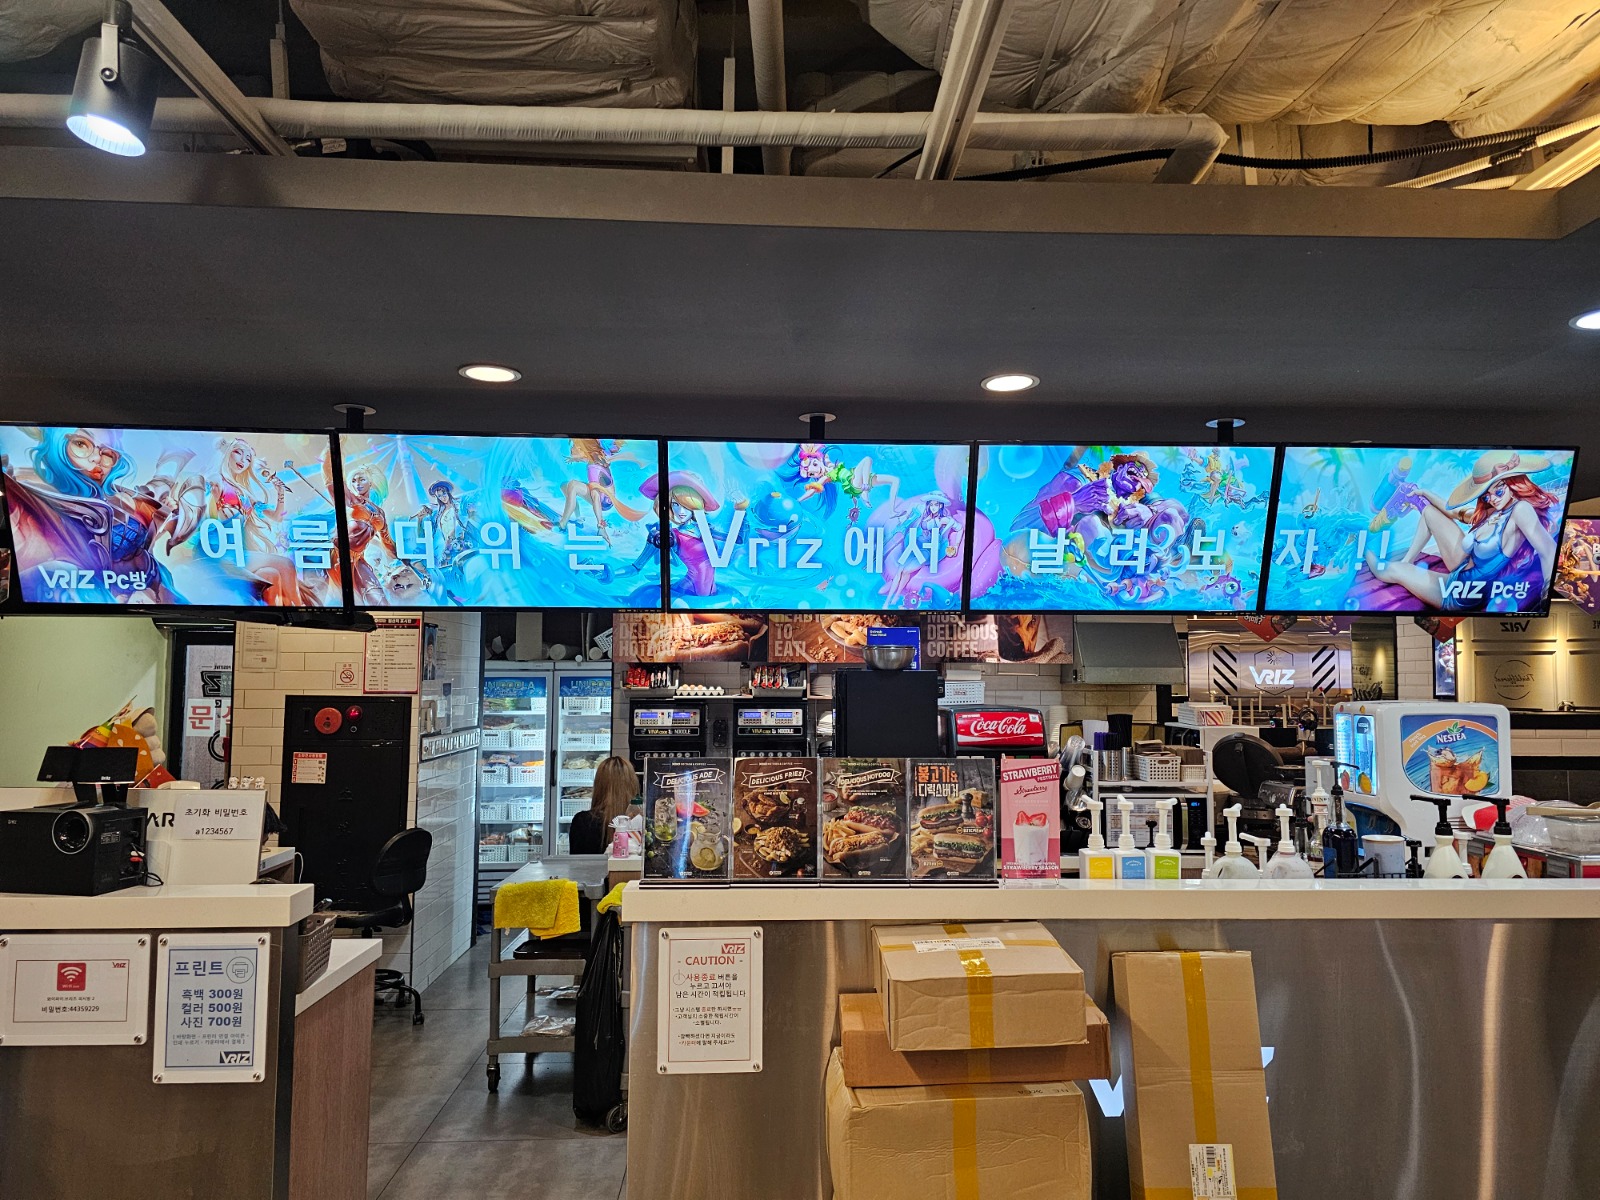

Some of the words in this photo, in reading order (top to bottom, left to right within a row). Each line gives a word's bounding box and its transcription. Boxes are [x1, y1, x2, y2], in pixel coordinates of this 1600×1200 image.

[696, 510, 823, 569] Vriz
[38, 565, 95, 589] VRIZ
[103, 570, 147, 591] Pc방
[1438, 577, 1484, 599] VRIZ
[1490, 581, 1531, 599] Pc방
[775, 623, 793, 639] TO
[927, 624, 999, 641] DELICIOUS
[774, 640, 806, 657] EAT!
[927, 641, 978, 657] COFFEE
[1248, 666, 1296, 685] VRIZ
[970, 716, 1028, 736] Coca-Cola
[1436, 732, 1467, 744] NESTEA
[699, 771, 713, 780] ADE
[751, 773, 784, 785] DELICIOUS
[784, 770, 803, 779] FRIES
[1002, 764, 1058, 781] STRAWBERRY
[185, 808, 211, 817] 초기화
[214, 808, 248, 817] 비밀번호
[722, 943, 746, 954] VRIZ
[174, 961, 224, 976] 프린트
[685, 956, 735, 966] CAUTION
[686, 973, 716, 981] 사용종료
[718, 973, 738, 981] 버튼을
[182, 989, 204, 1001] 흑백
[208, 988, 243, 1000] 300원
[691, 990, 711, 998] 시간이
[181, 1003, 204, 1015] 컬러
[208, 1002, 243, 1014] 500원
[180, 1016, 203, 1028] 사진
[207, 1016, 242, 1028] 700원
[220, 1051, 250, 1064] VRIZ
